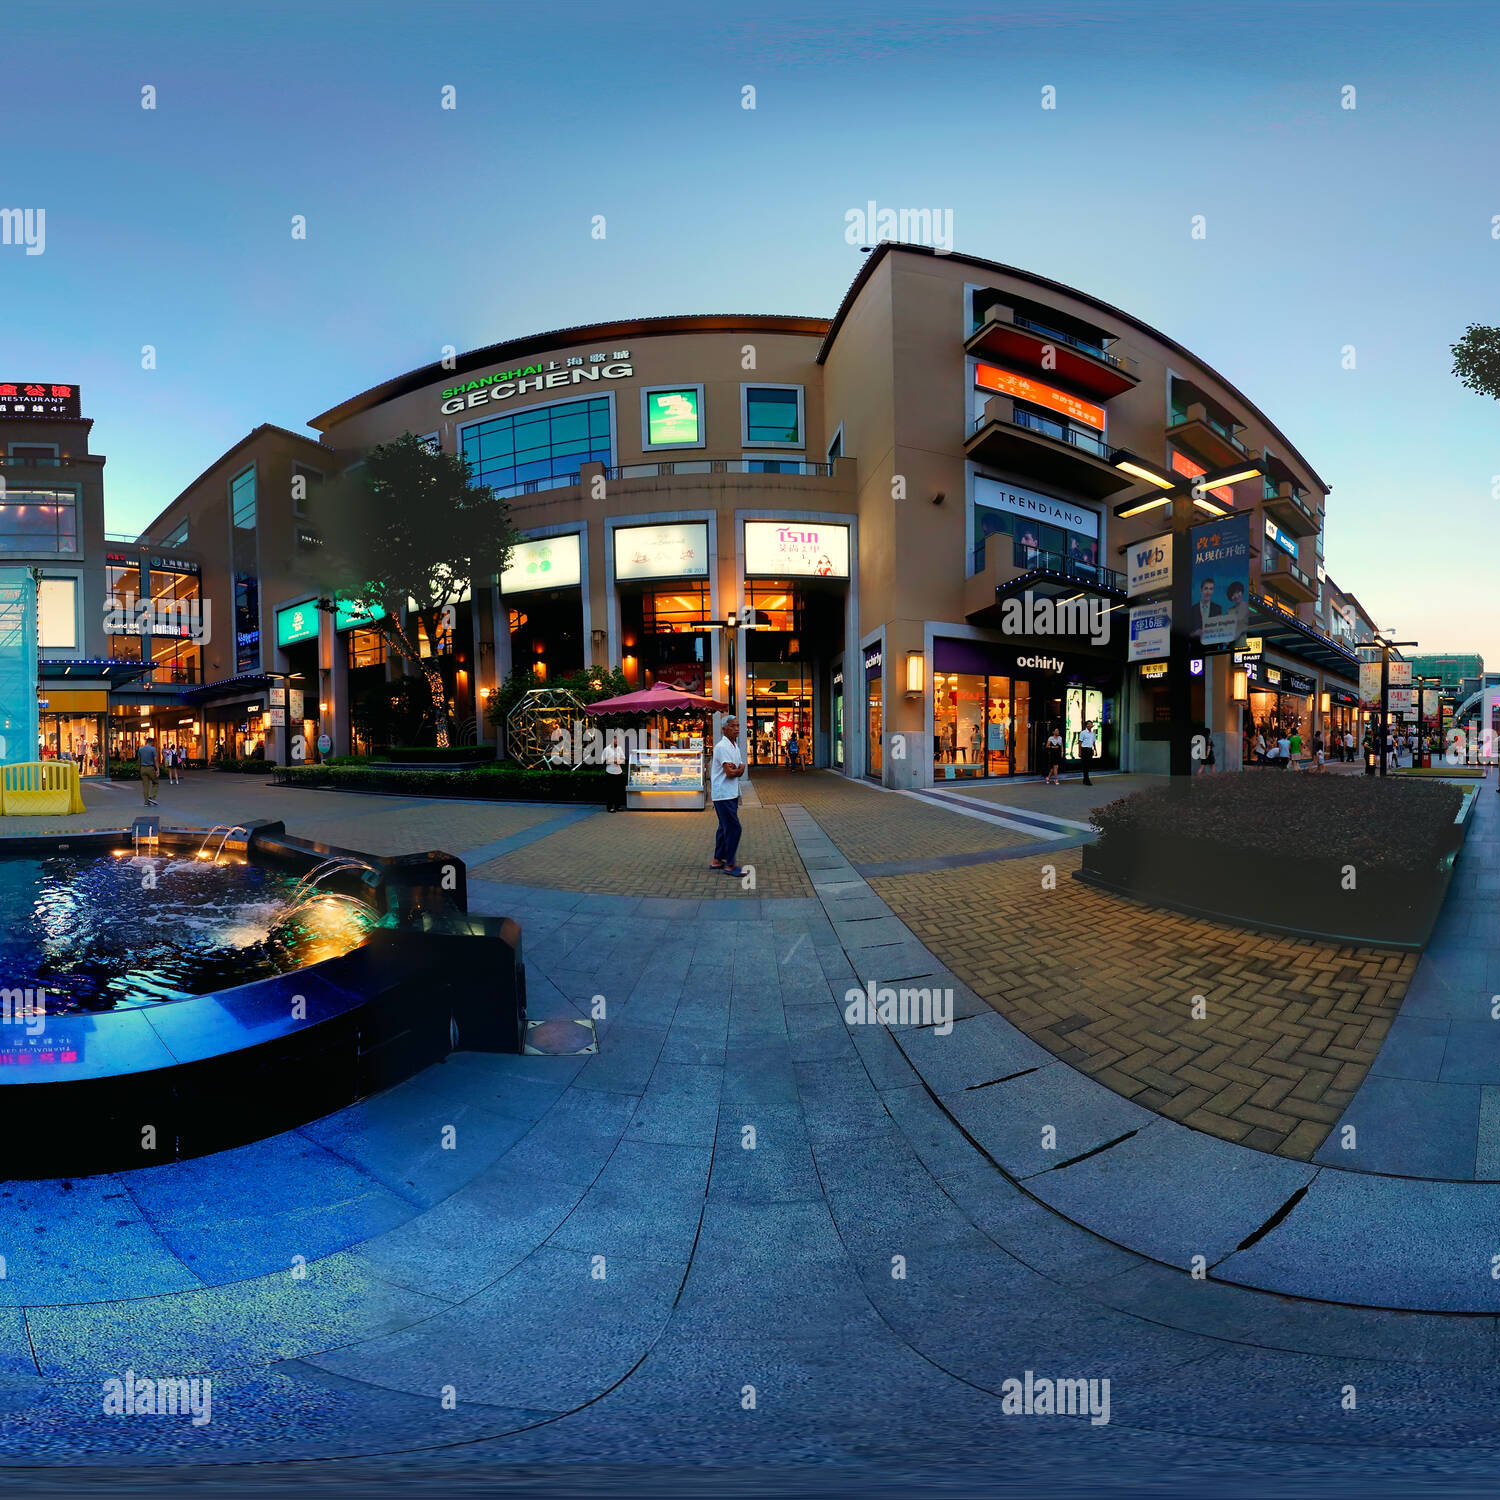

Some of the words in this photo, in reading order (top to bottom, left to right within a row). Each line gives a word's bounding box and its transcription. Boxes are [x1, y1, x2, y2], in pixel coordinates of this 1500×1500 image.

[545, 350, 631, 371] 上海歌城
[440, 364, 543, 399] SHANGHAI
[441, 363, 633, 415] GECHENG
[1000, 492, 1083, 524] TRENDIANO
[1195, 544, 1246, 564] 从现在开始
[865, 652, 882, 669] ochirly
[1017, 655, 1064, 673] ochirly
